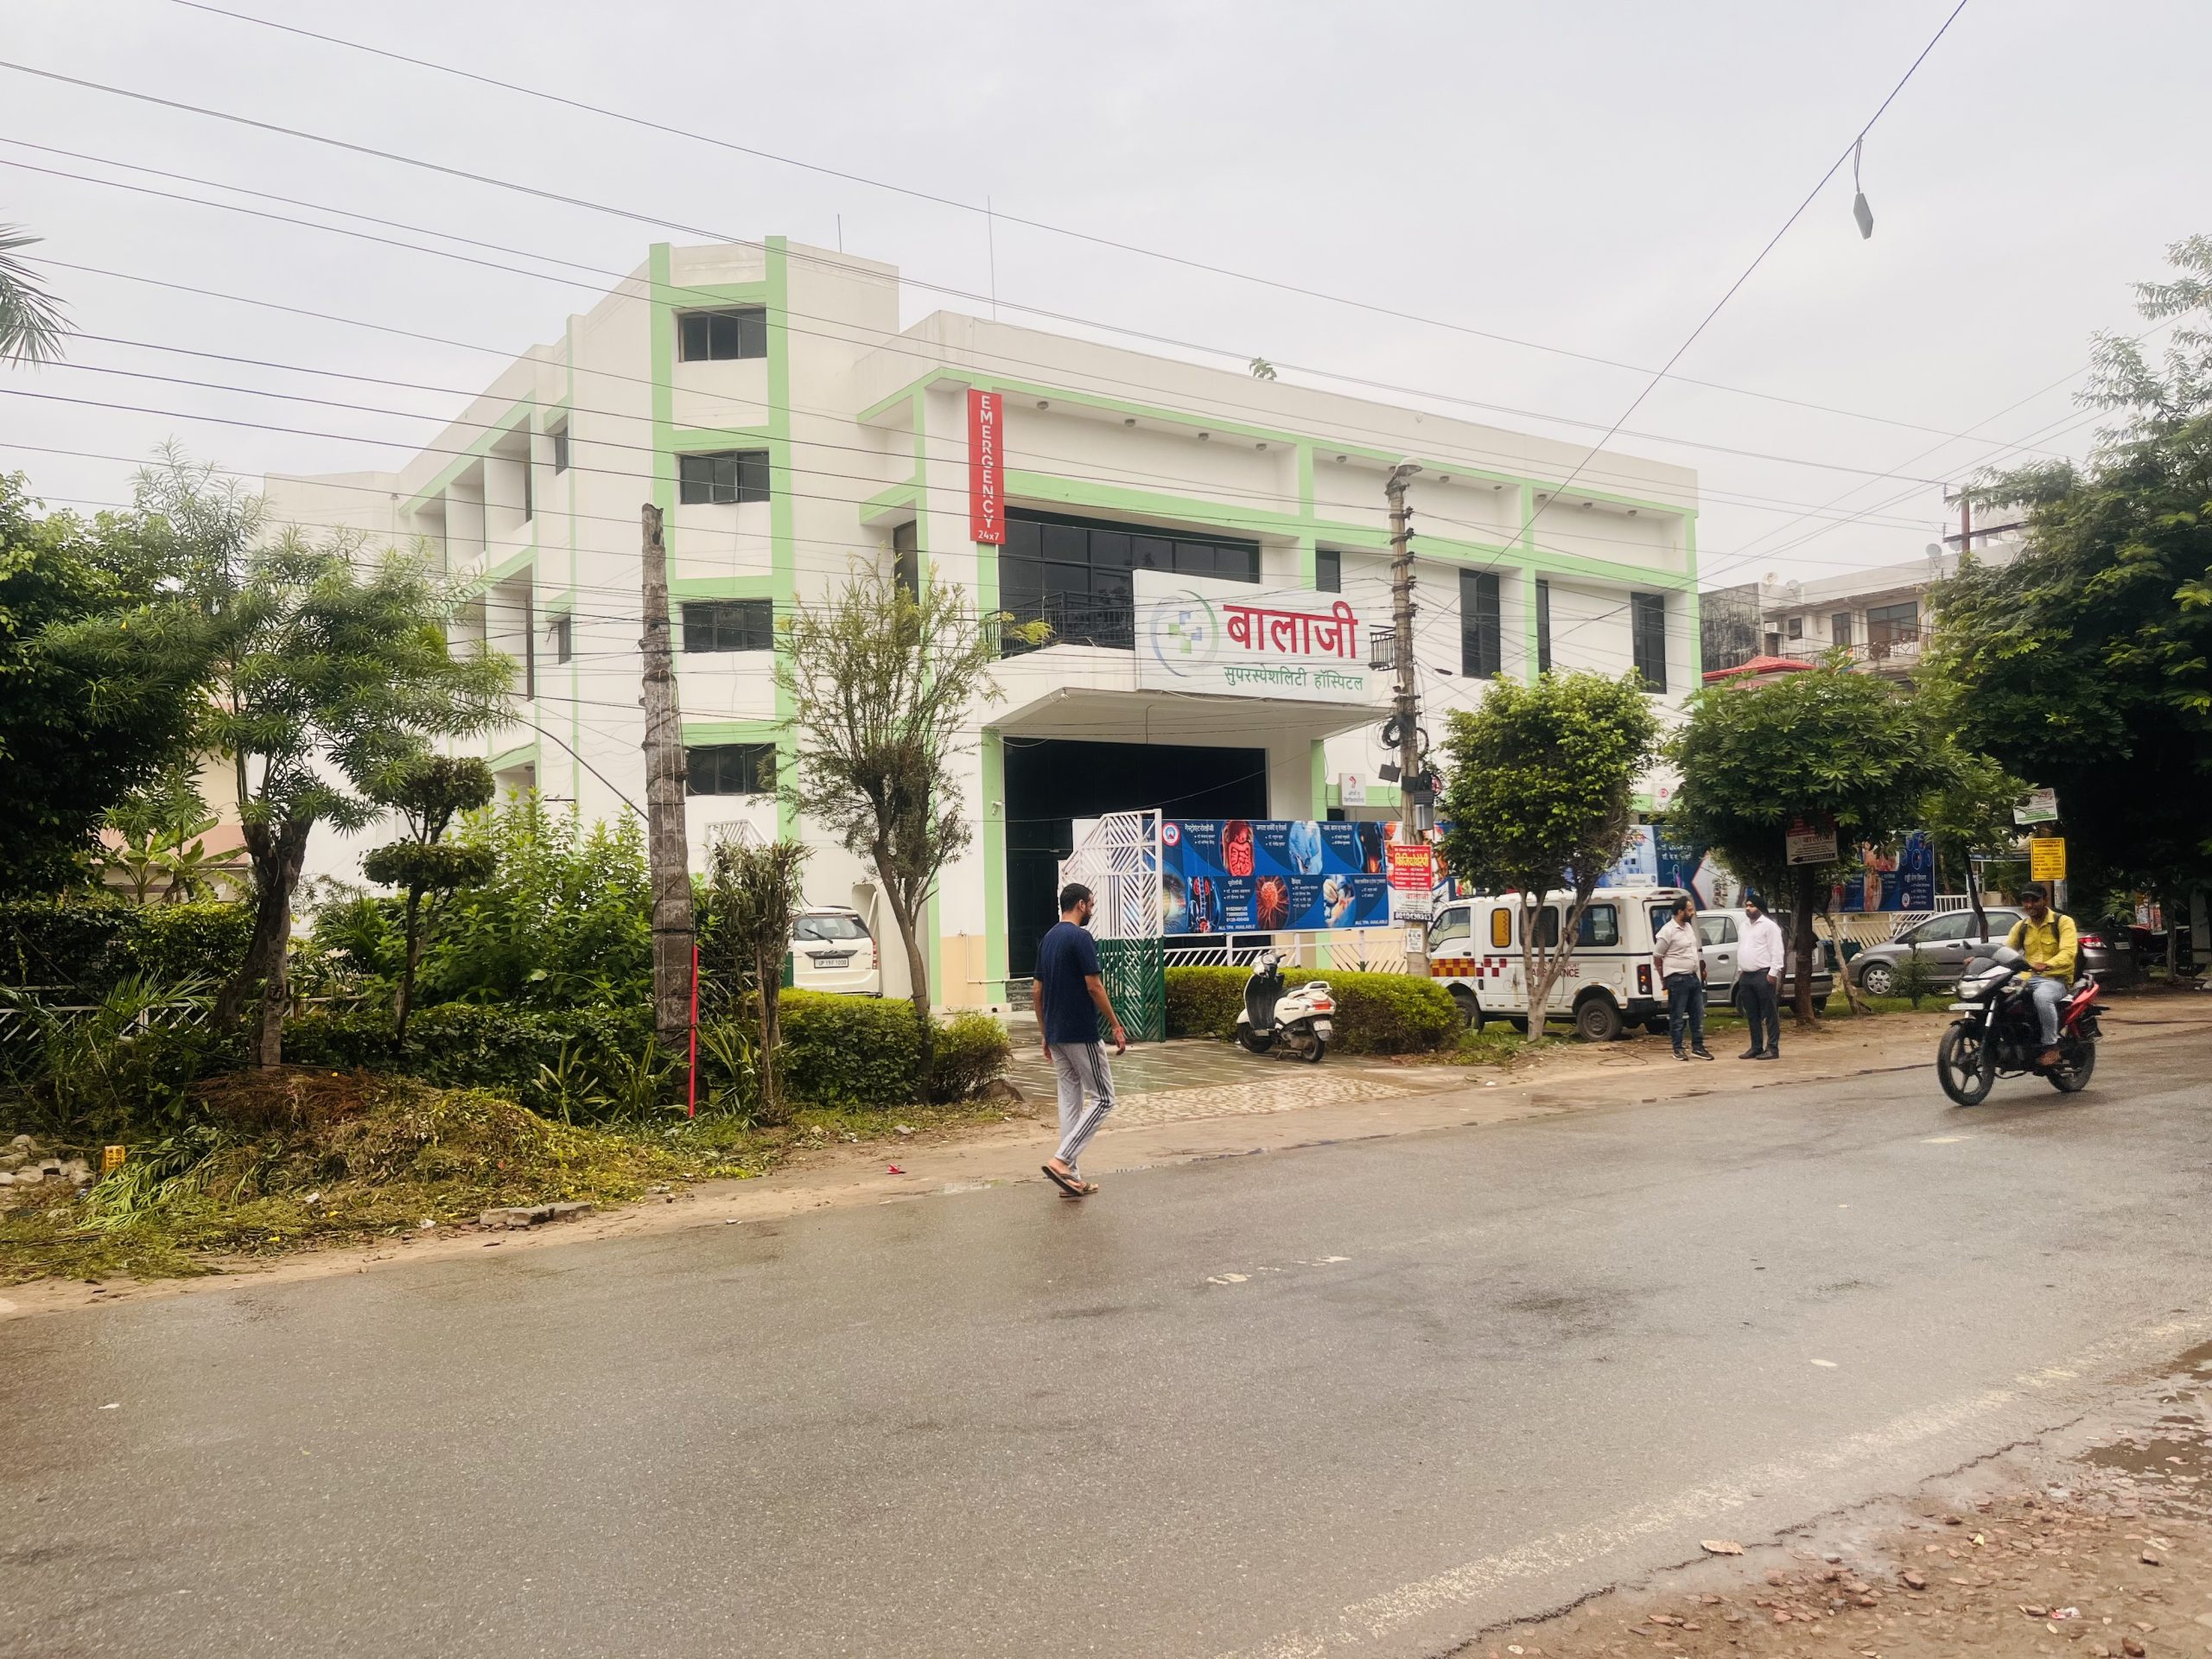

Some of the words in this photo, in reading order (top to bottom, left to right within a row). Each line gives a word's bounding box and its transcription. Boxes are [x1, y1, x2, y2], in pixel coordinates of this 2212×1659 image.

[981, 395, 994, 528] EMERGENCY
[978, 530, 1000, 541] 24x7
[1224, 601, 1358, 658] बालाजी
[1224, 664, 1306, 686] सुपरस्पेशलिटी
[1313, 669, 1363, 690] हॉस्पिटल
